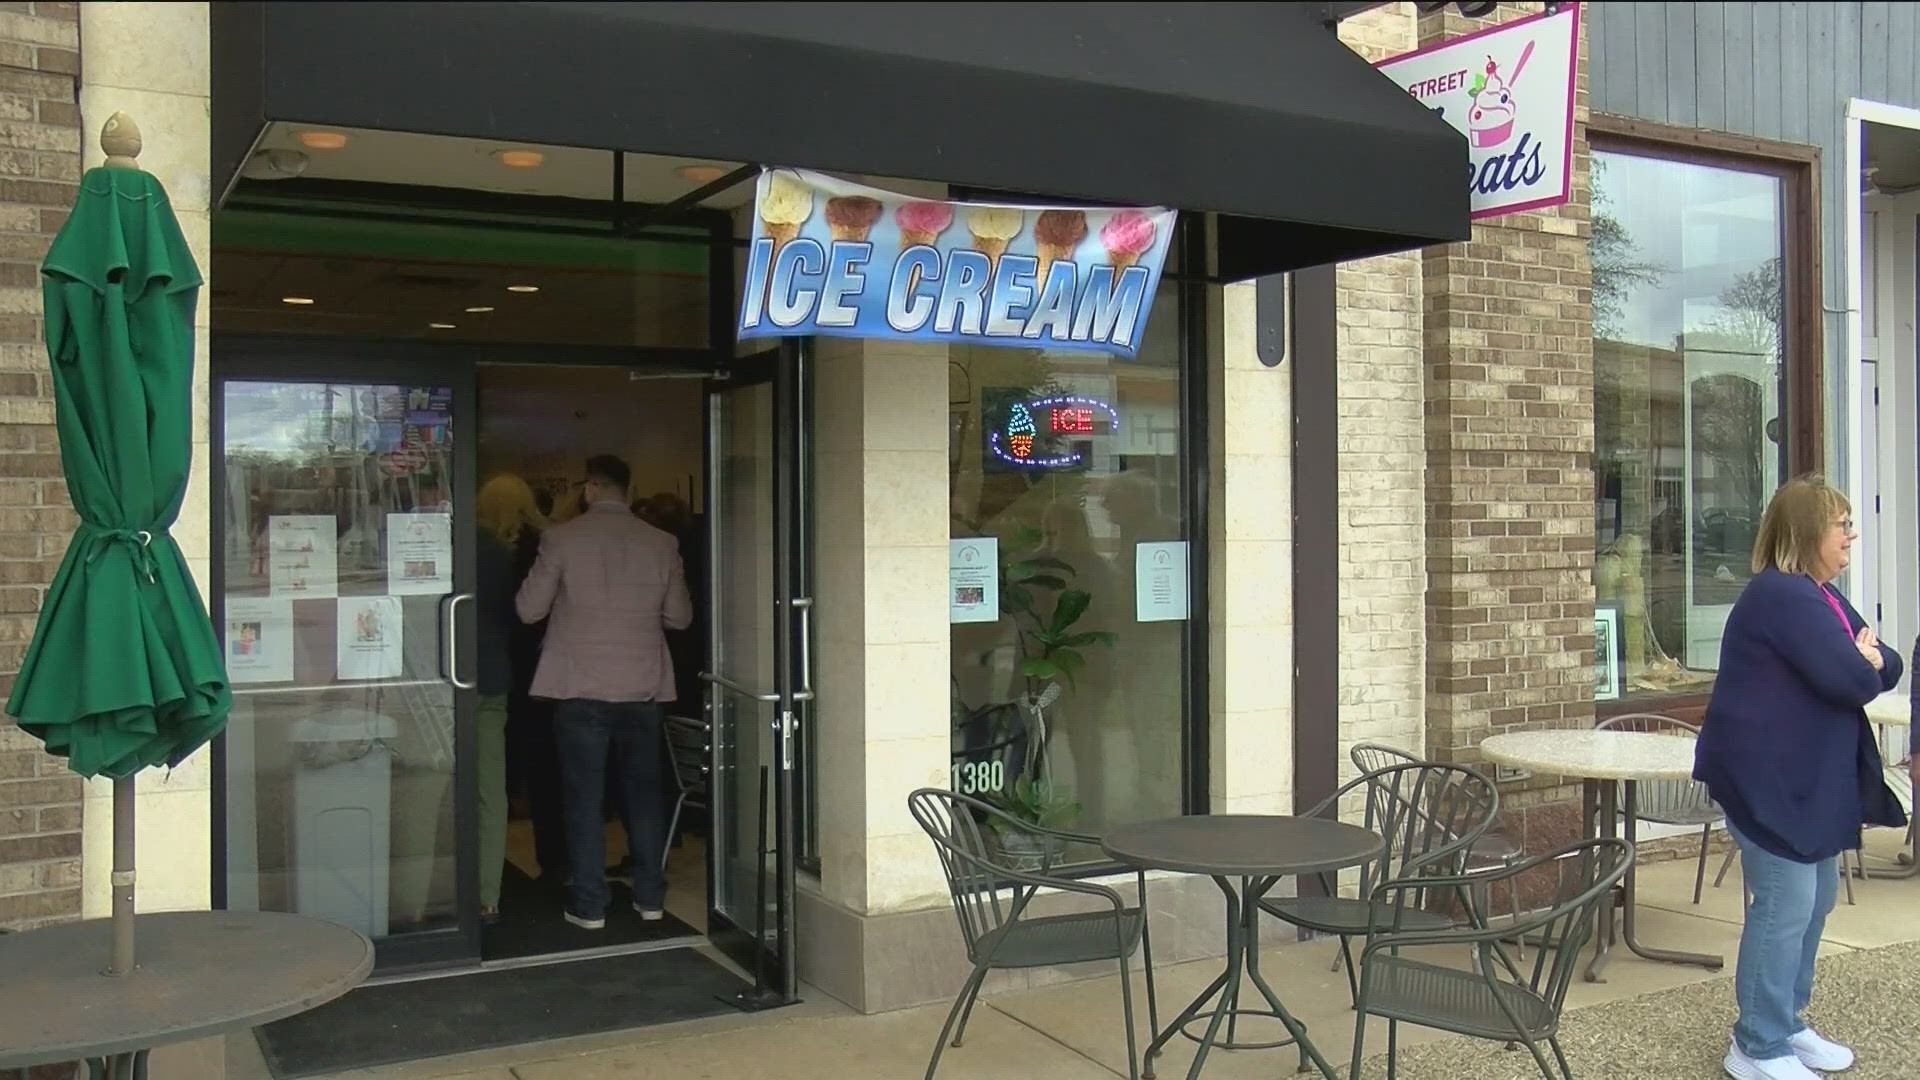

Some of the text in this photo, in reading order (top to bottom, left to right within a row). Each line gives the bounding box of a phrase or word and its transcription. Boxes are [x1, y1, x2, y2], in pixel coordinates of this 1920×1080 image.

[1408, 70, 1467, 98] STREET
[743, 236, 1149, 347] ICE CREAM
[1051, 408, 1093, 431] ICE
[952, 759, 1004, 794] 1380
